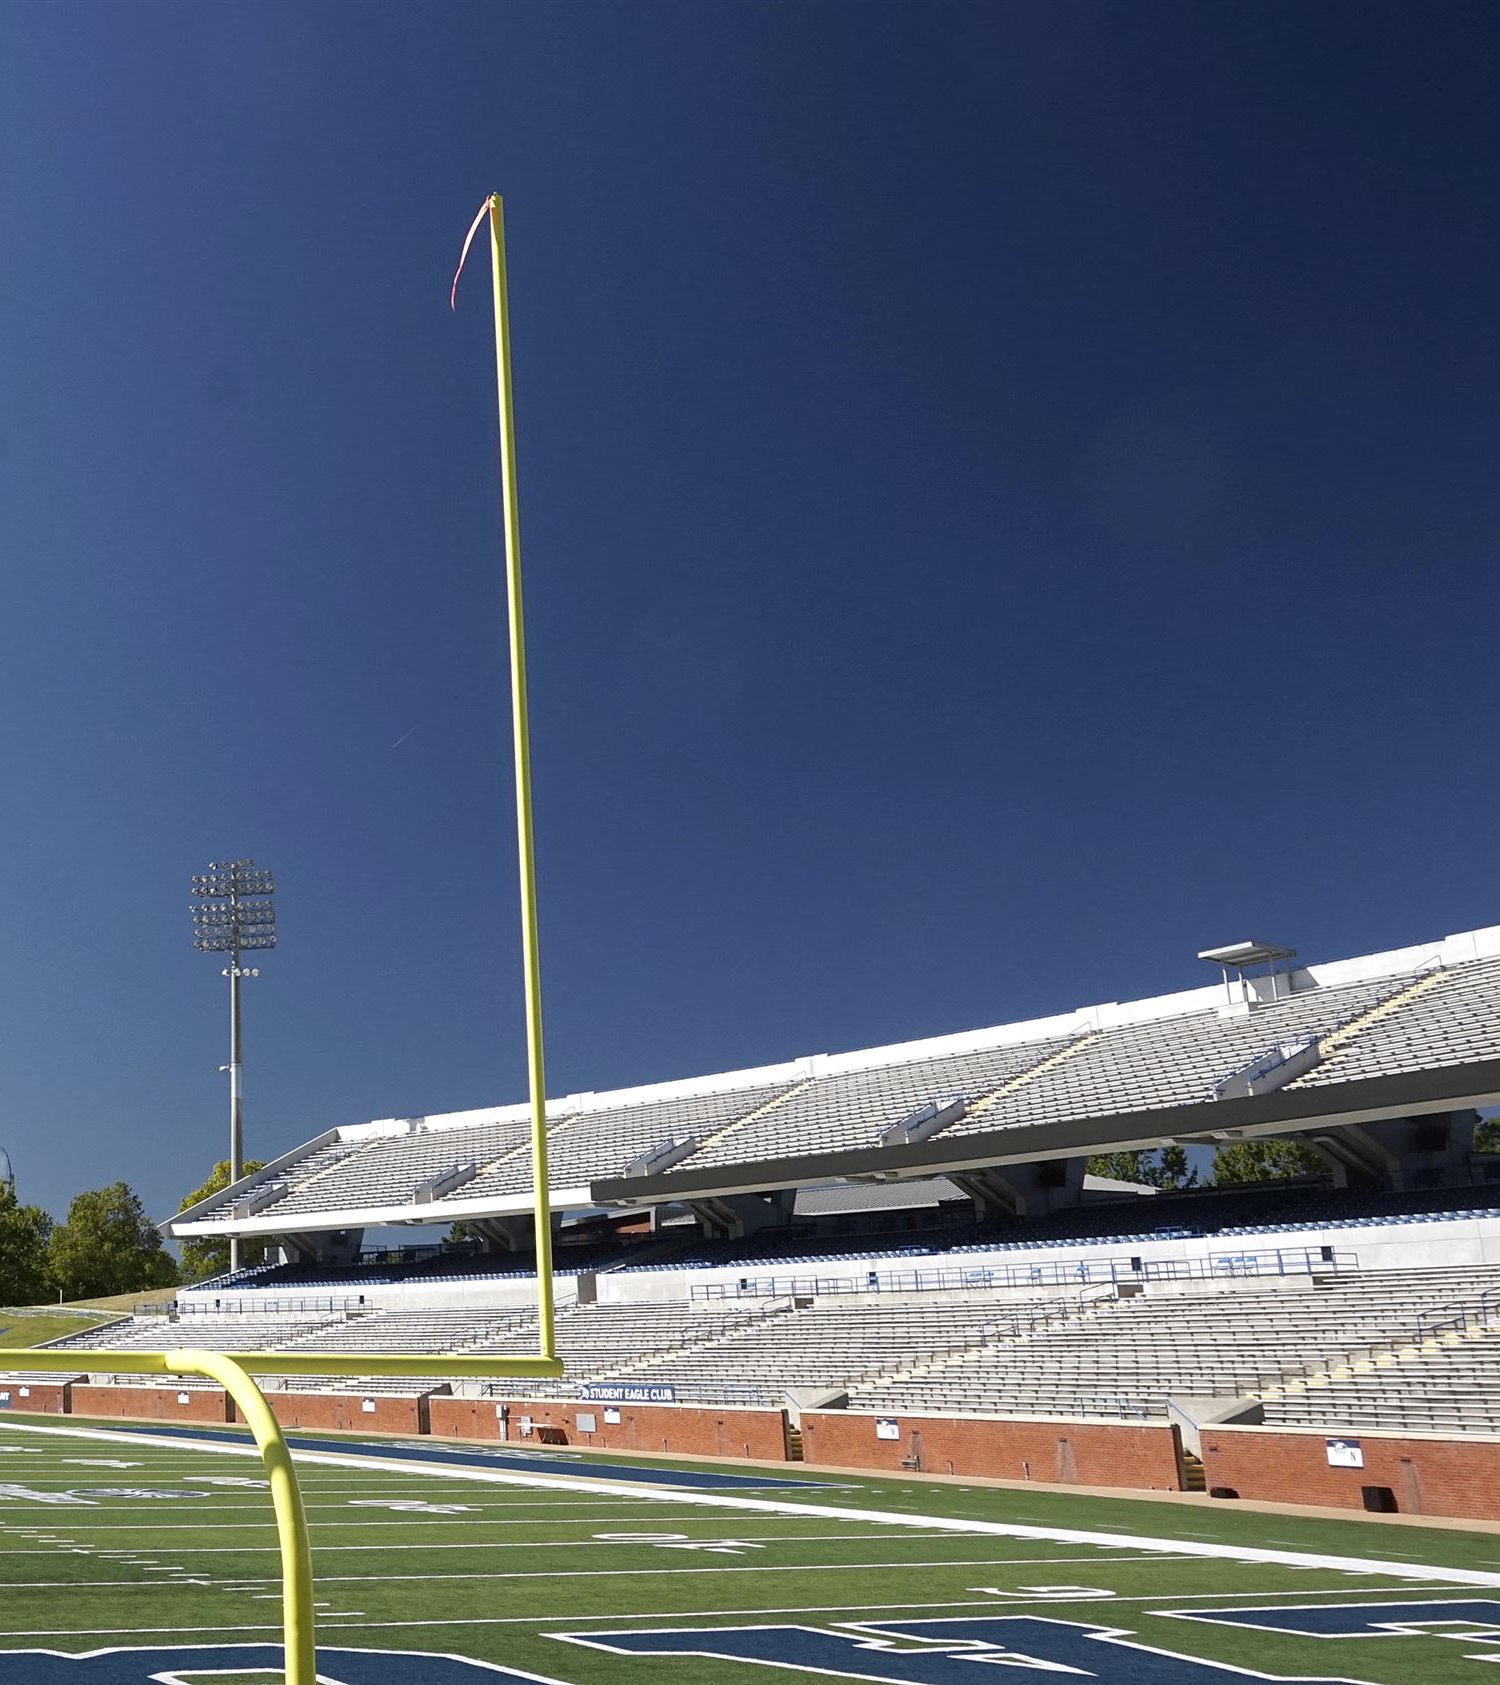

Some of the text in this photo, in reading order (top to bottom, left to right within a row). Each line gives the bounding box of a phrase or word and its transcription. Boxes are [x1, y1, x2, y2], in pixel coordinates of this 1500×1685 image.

[590, 1388, 672, 1400] STUDENT EAGLE CLUB
